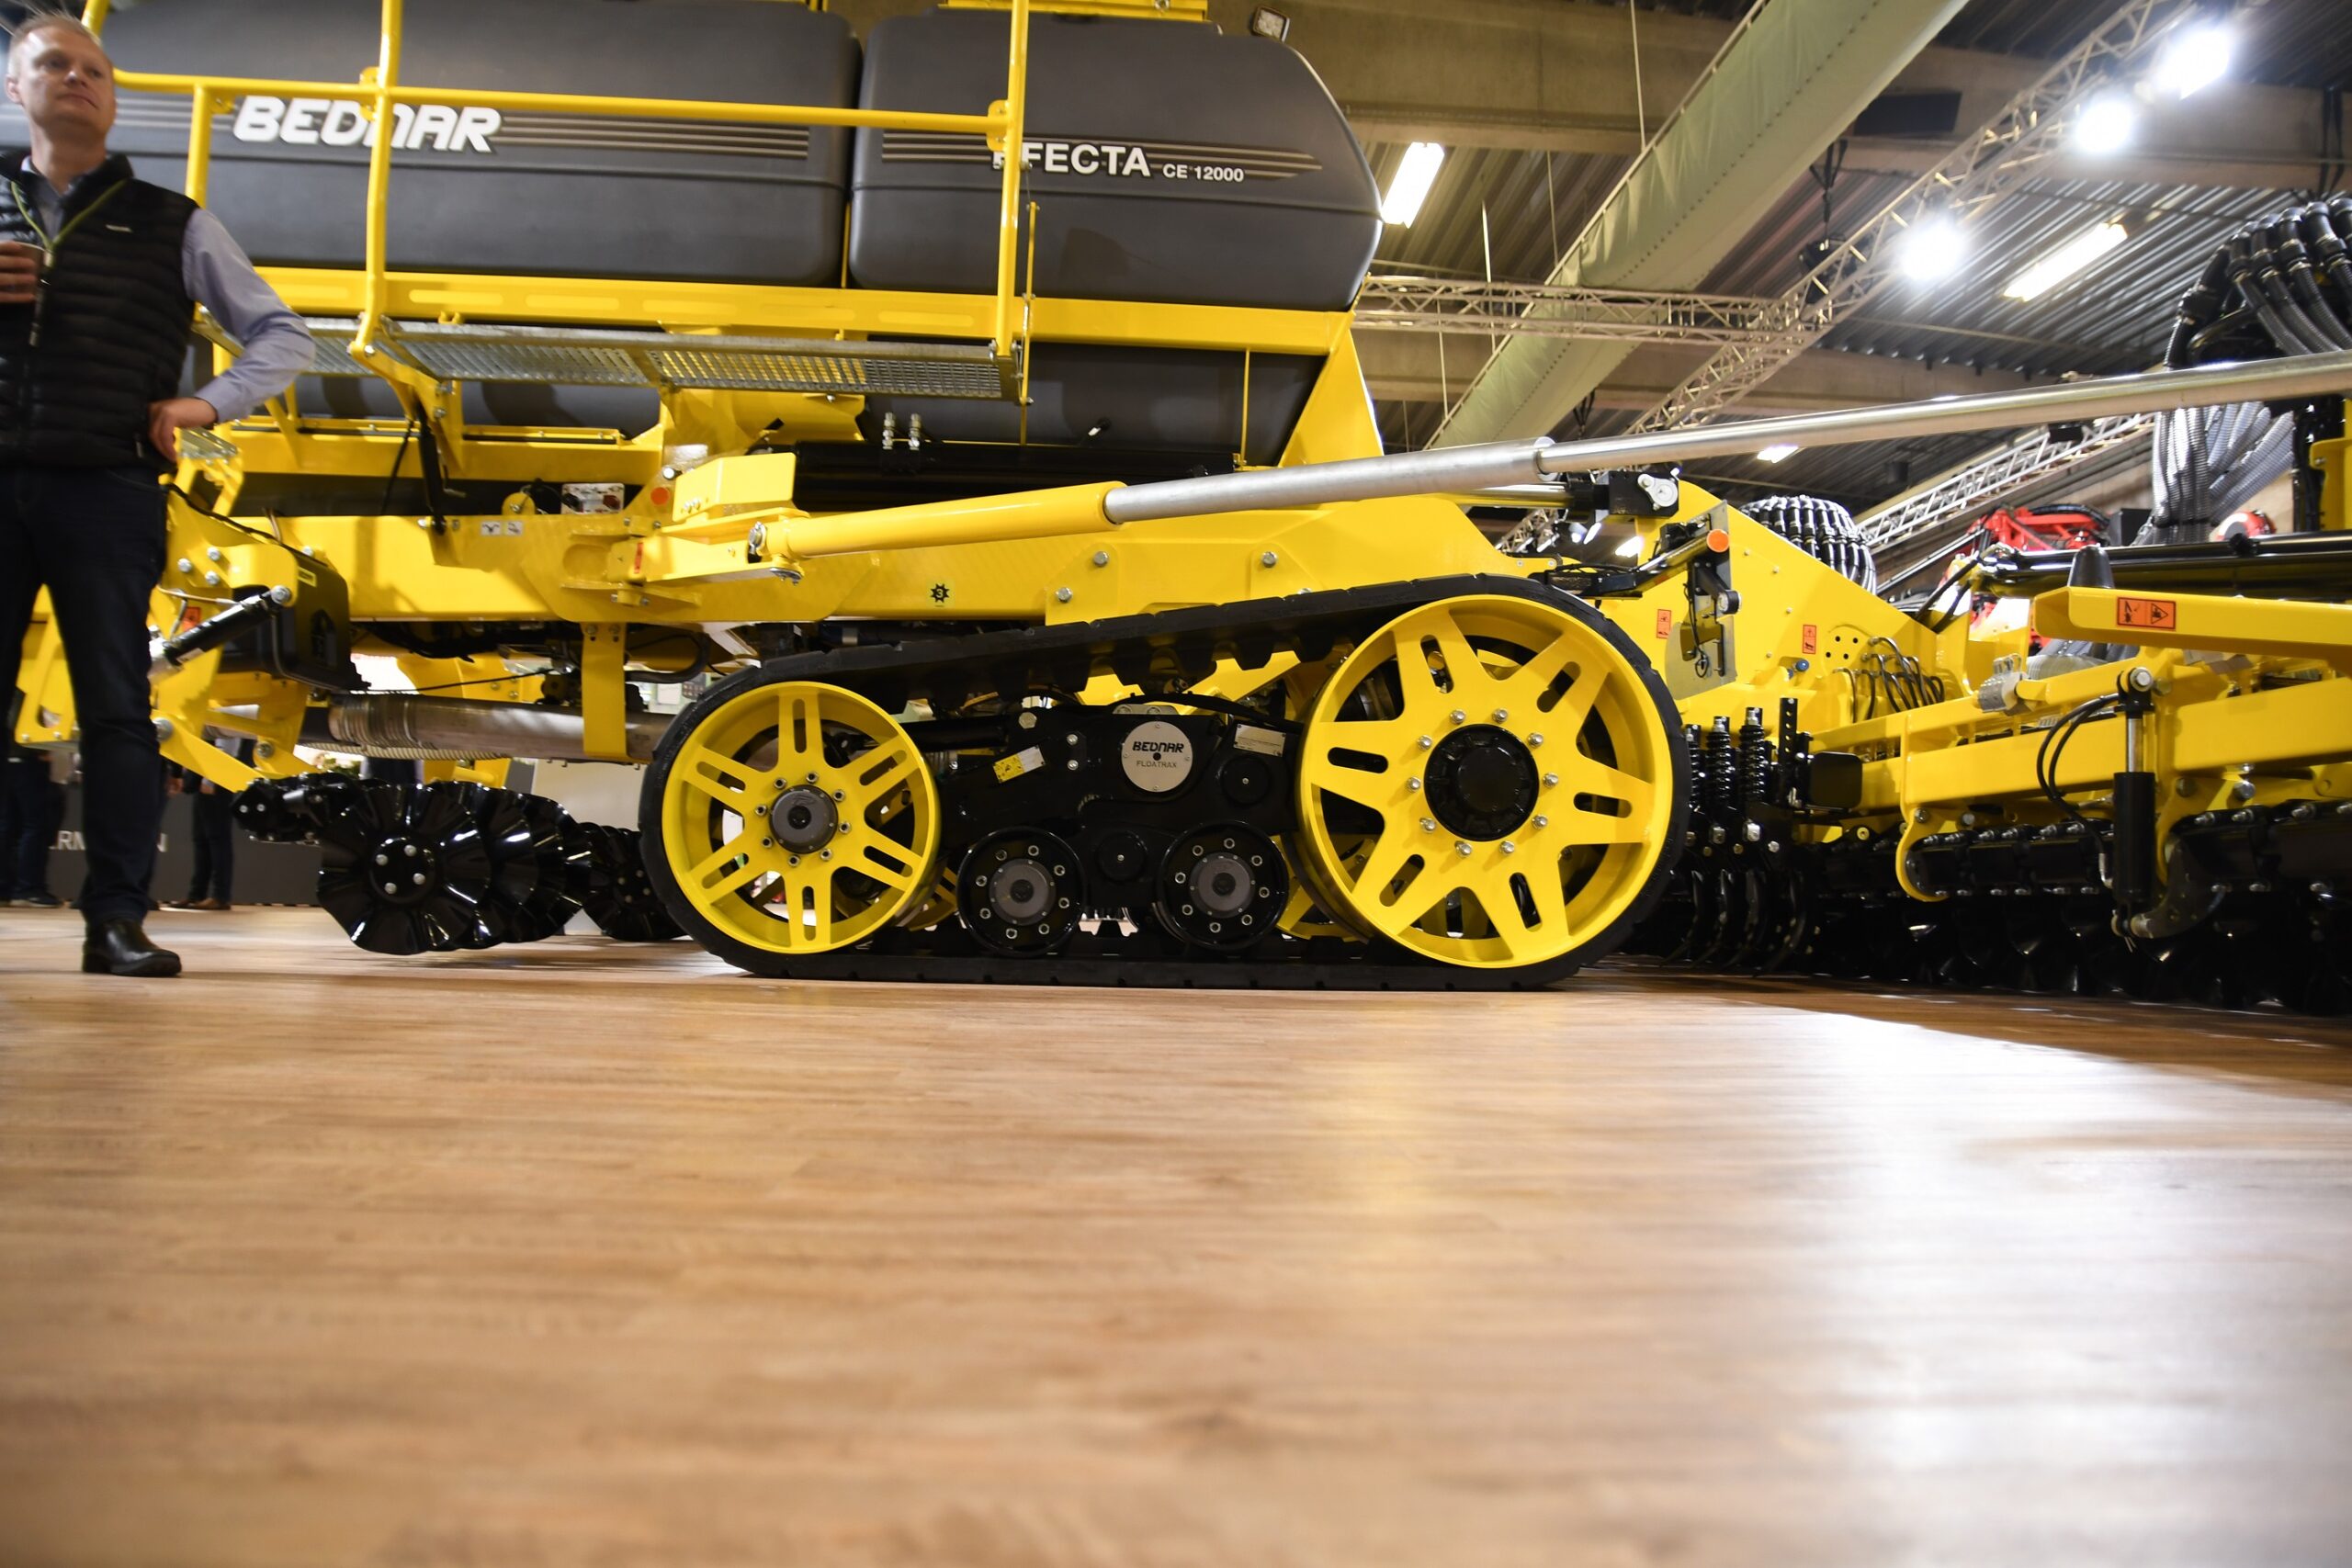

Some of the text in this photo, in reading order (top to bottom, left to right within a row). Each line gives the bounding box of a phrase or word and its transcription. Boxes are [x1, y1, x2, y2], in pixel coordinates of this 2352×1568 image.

[1162, 163, 1188, 179] CE
[1194, 165, 1244, 183] 12000
[1132, 741, 1184, 753] BEDNAR
